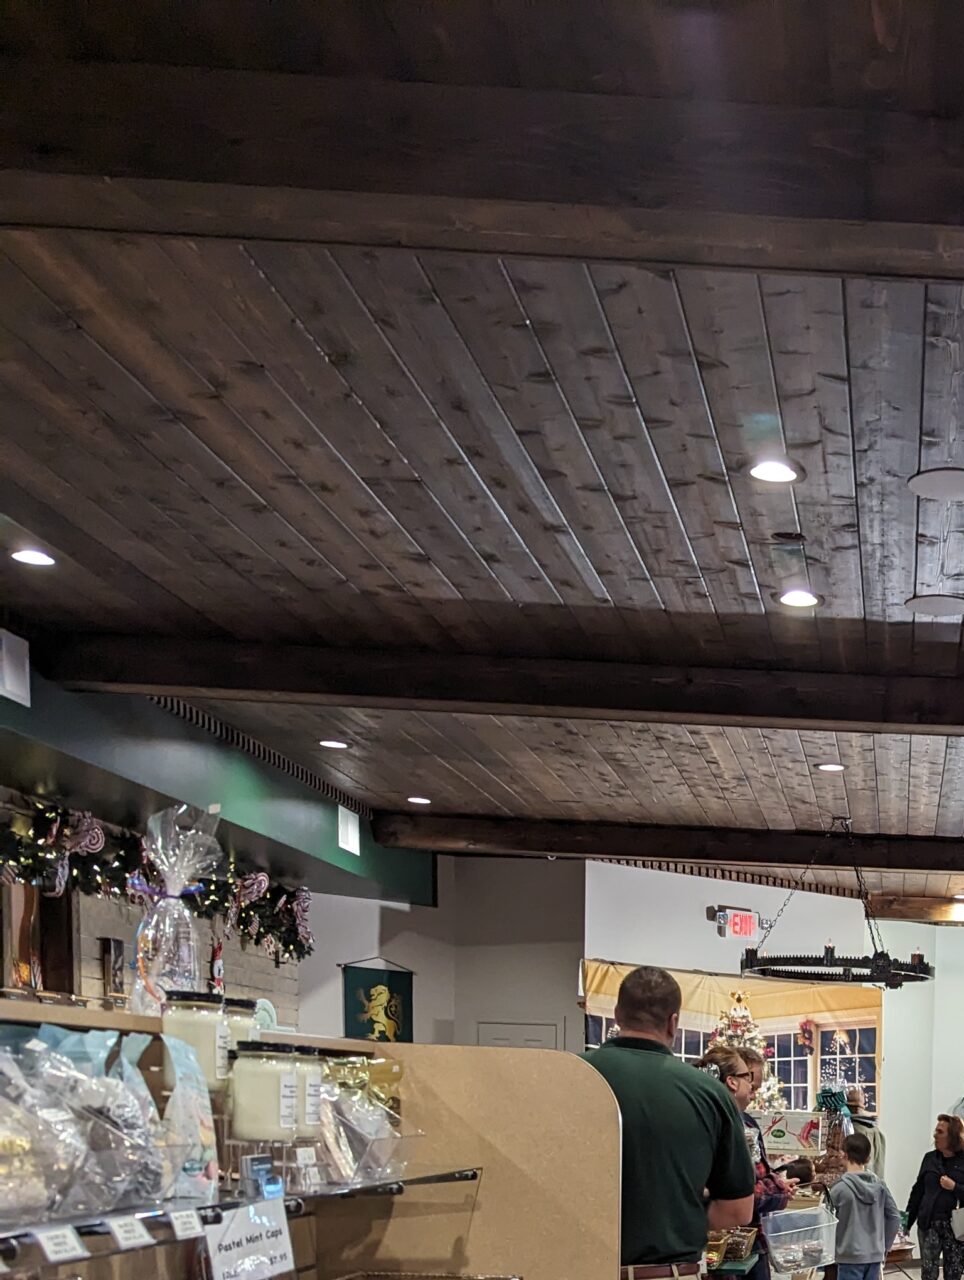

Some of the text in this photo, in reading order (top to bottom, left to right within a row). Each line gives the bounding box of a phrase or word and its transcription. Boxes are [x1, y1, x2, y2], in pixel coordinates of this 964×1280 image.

[732, 913, 753, 937] EXIT
[217, 1228, 283, 1253] Pastel Mint Caps
